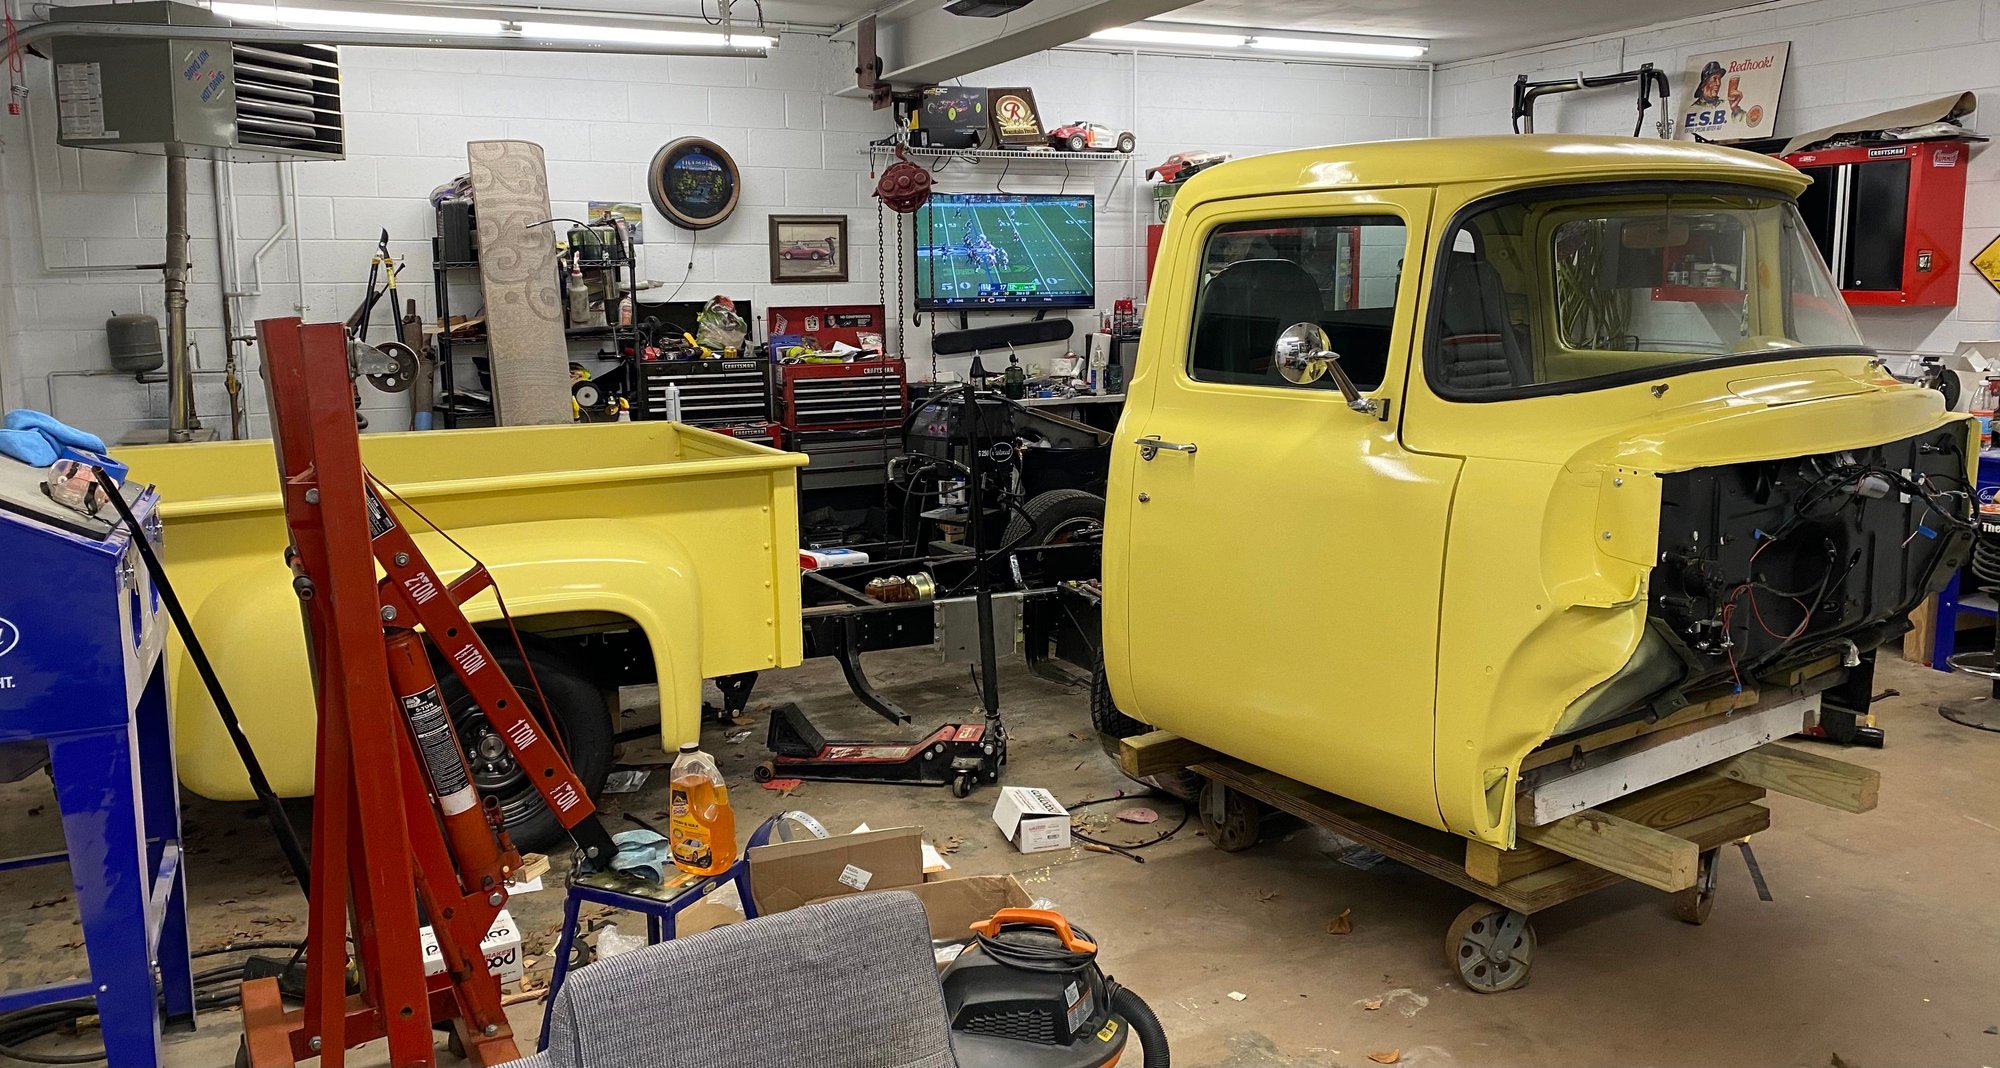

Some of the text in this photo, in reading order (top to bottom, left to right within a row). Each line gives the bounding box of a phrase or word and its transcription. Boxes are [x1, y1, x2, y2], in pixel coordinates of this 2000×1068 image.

[197, 49, 209, 65] HOT
[1728, 56, 1774, 73] Redhook!
[201, 86, 212, 103] HOT
[1685, 110, 1727, 127] E.S.B.
[1870, 148, 1904, 156] CRAFTSMAN
[863, 366, 894, 375] CRAFTSAN
[1982, 522, 2000, 533] The
